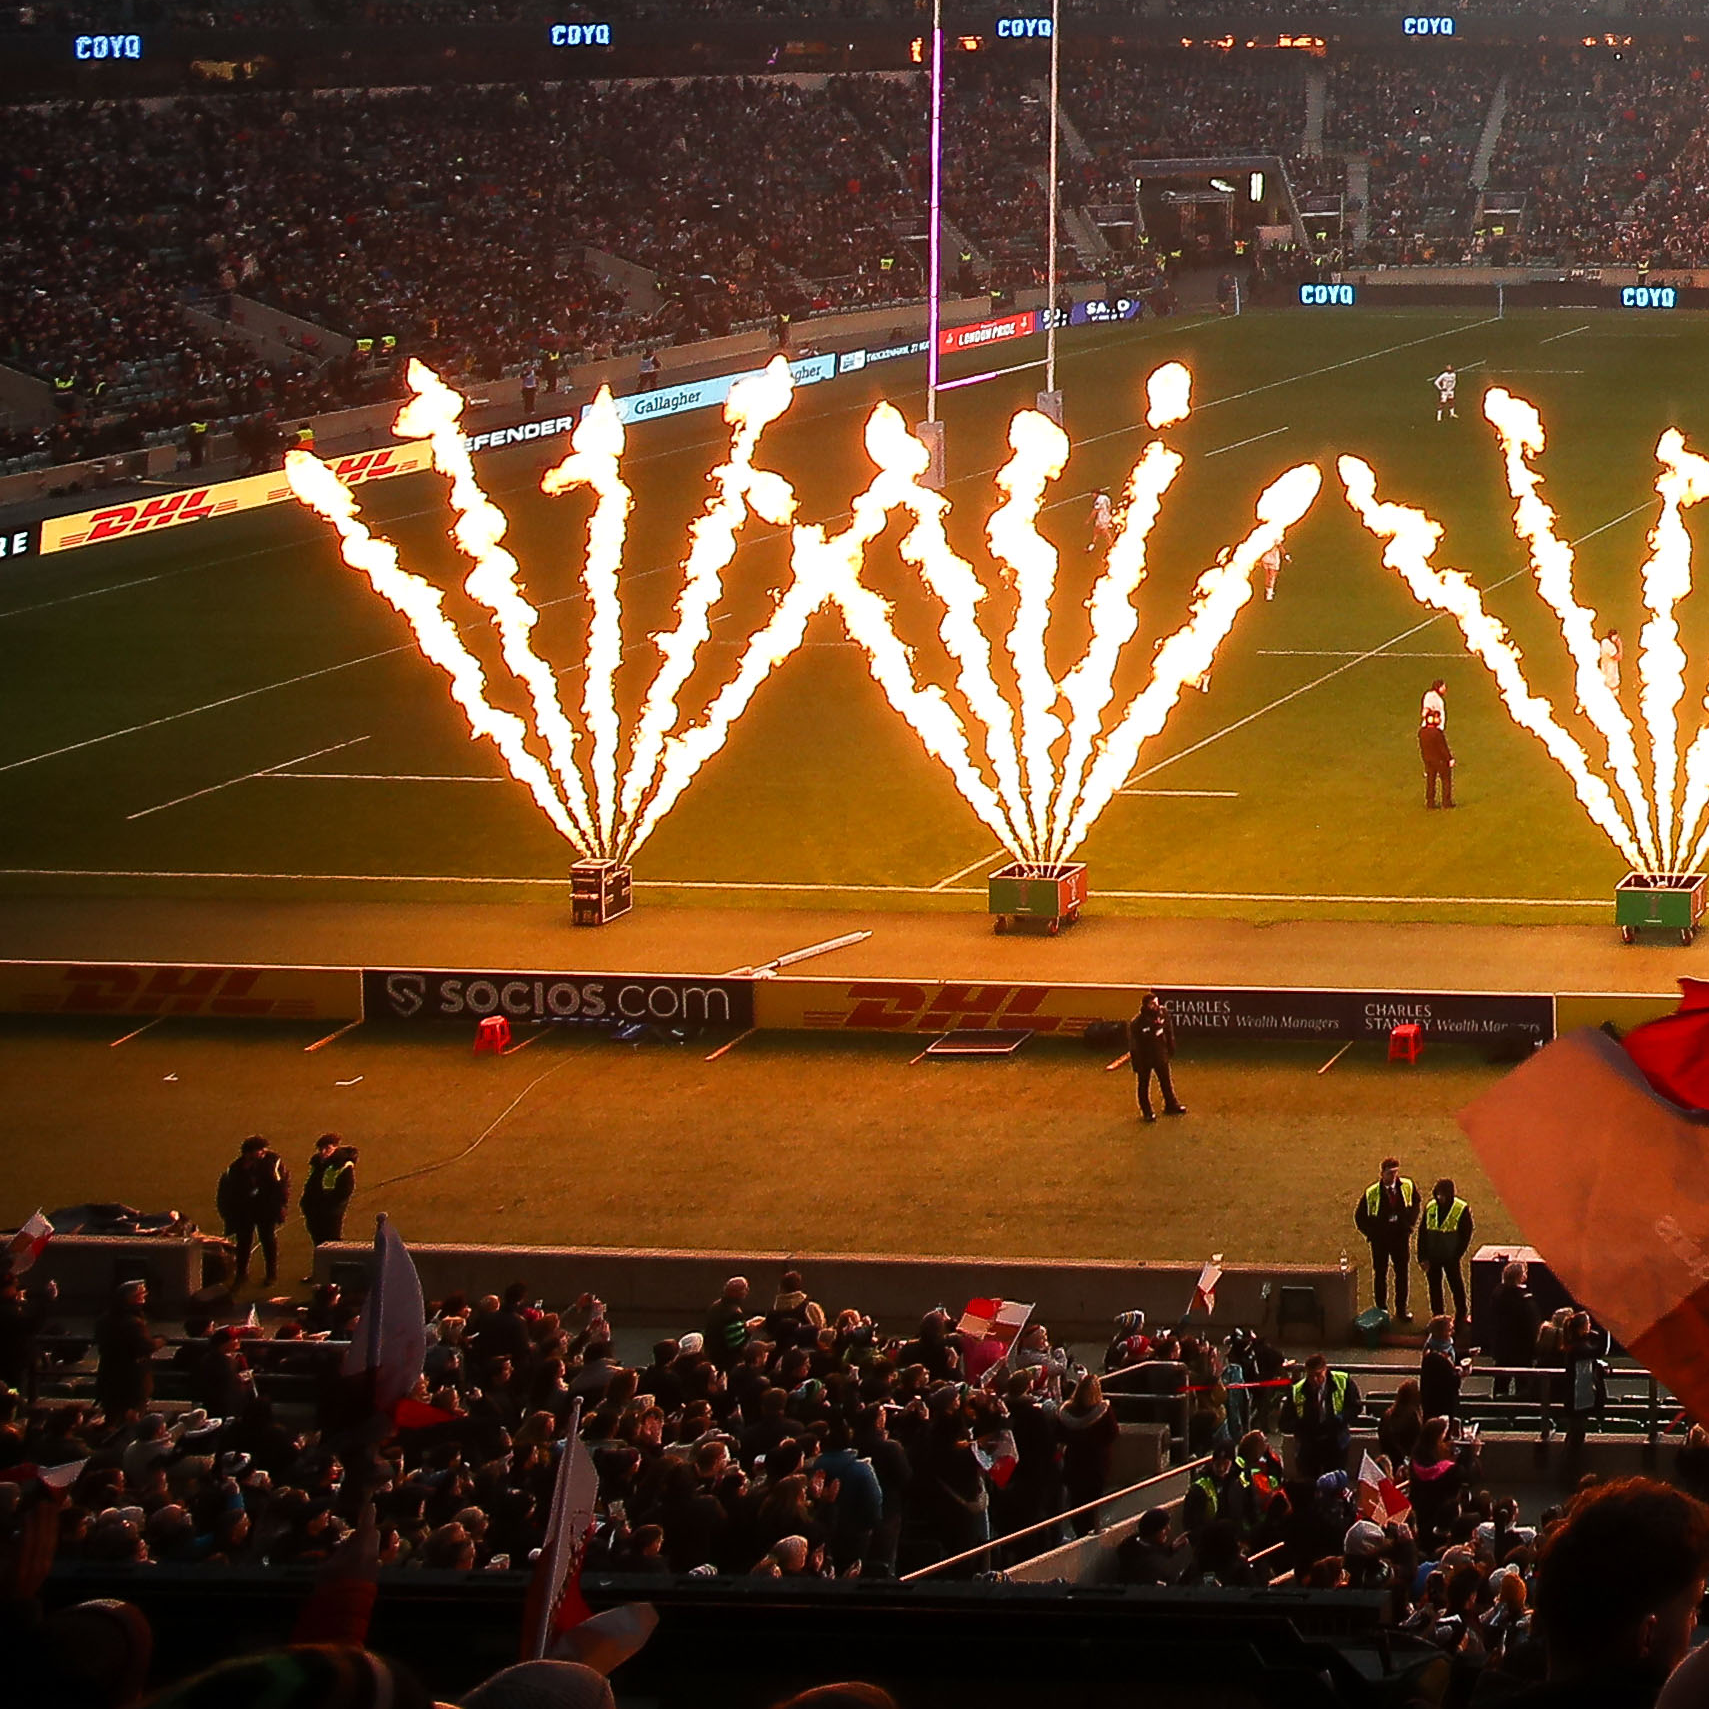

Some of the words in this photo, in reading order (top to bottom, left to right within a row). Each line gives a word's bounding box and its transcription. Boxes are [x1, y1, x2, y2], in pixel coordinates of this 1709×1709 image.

[552, 25, 609, 45] COYQ
[998, 19, 1052, 36] COYQ
[1405, 18, 1452, 35] COYQ
[76, 35, 140, 58] COYQ
[1302, 285, 1352, 304] COYQ
[1623, 288, 1674, 307] COYQ
[1086, 299, 1130, 315] SAO
[958, 326, 993, 346] LONDON
[634, 389, 701, 415] Gallagher
[465, 416, 573, 452] EFENDER
[87, 491, 216, 541] DHL
[62, 967, 278, 1014] DHL
[440, 980, 730, 1021] SOCIOS.com
[844, 985, 1063, 1030] DHL
[1164, 1000, 1231, 1014] CHARLES
[1364, 1003, 1432, 1018] CHARLES
[1236, 1015, 1278, 1028] Wealth
[1280, 1015, 1340, 1030] Managers
[1436, 1019, 1480, 1033] Wealth
